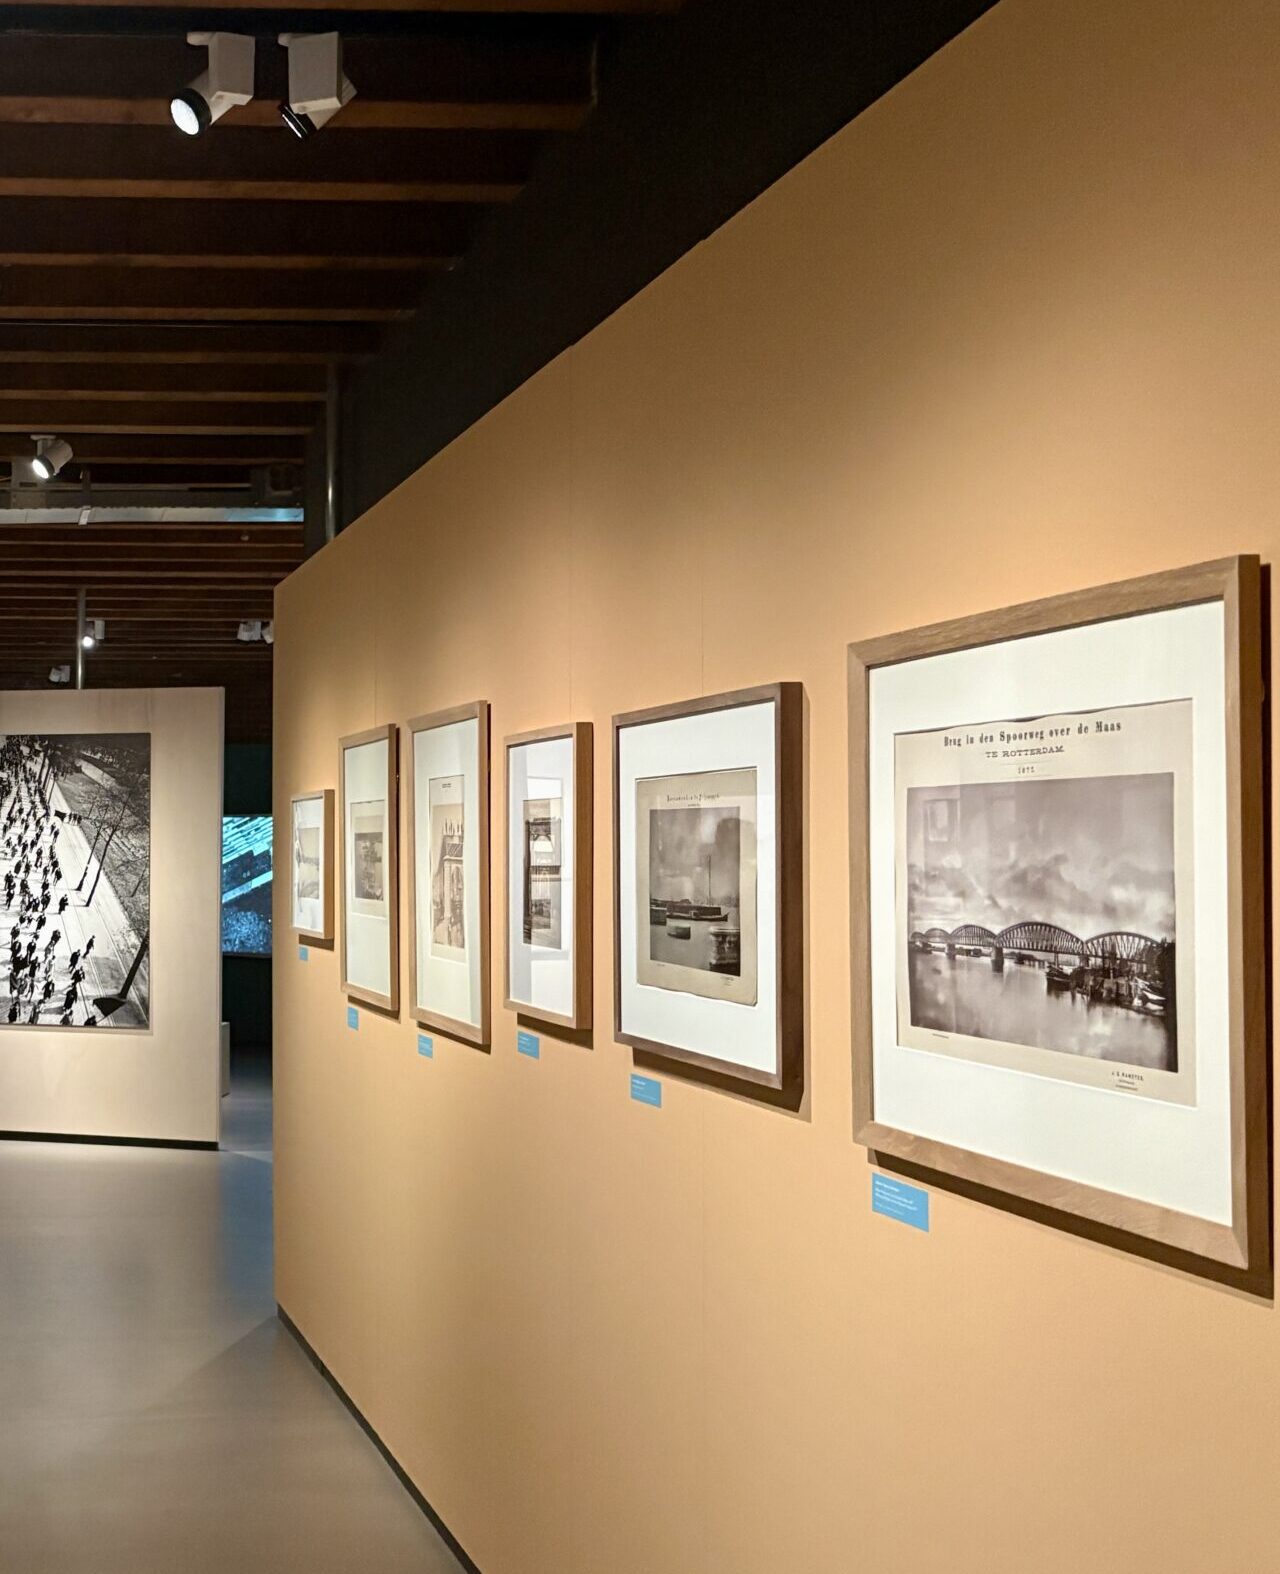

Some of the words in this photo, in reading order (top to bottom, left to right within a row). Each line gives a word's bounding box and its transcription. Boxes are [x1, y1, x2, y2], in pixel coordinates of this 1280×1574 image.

[944, 736, 962, 747] Brug
[966, 734, 974, 744] in
[979, 732, 994, 744] den
[999, 731, 1044, 744] Spoorweg
[1049, 727, 1070, 738] over
[1077, 723, 1089, 735] de
[1095, 721, 1122, 733] Maas
